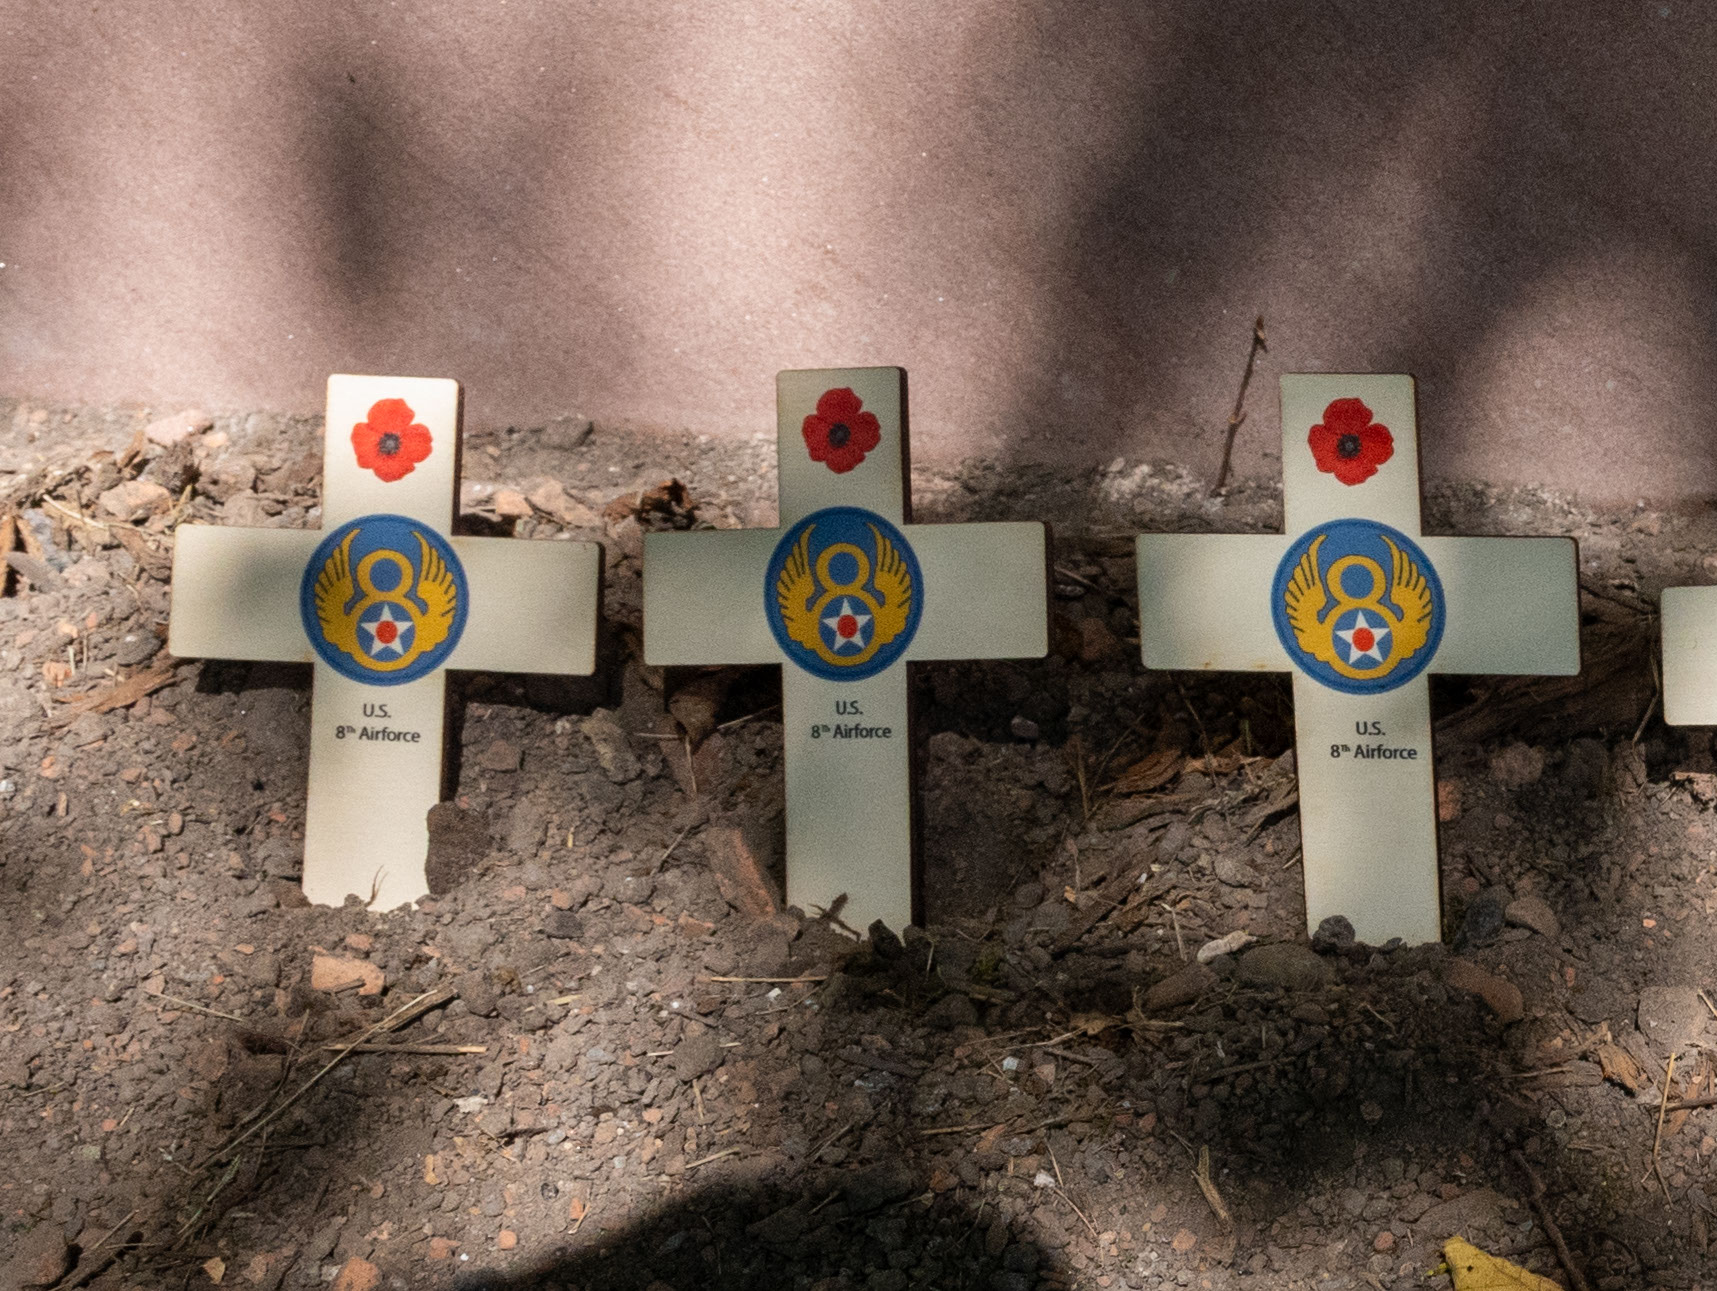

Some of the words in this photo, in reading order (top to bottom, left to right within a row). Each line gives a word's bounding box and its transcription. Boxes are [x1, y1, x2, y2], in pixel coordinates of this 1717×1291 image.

[363, 704, 391, 718] U.S.
[836, 700, 863, 715] U.S.
[359, 726, 420, 742] Airforce
[833, 723, 891, 738] Airforce
[1356, 721, 1386, 736] U.S.
[1354, 744, 1417, 759] Airforce
